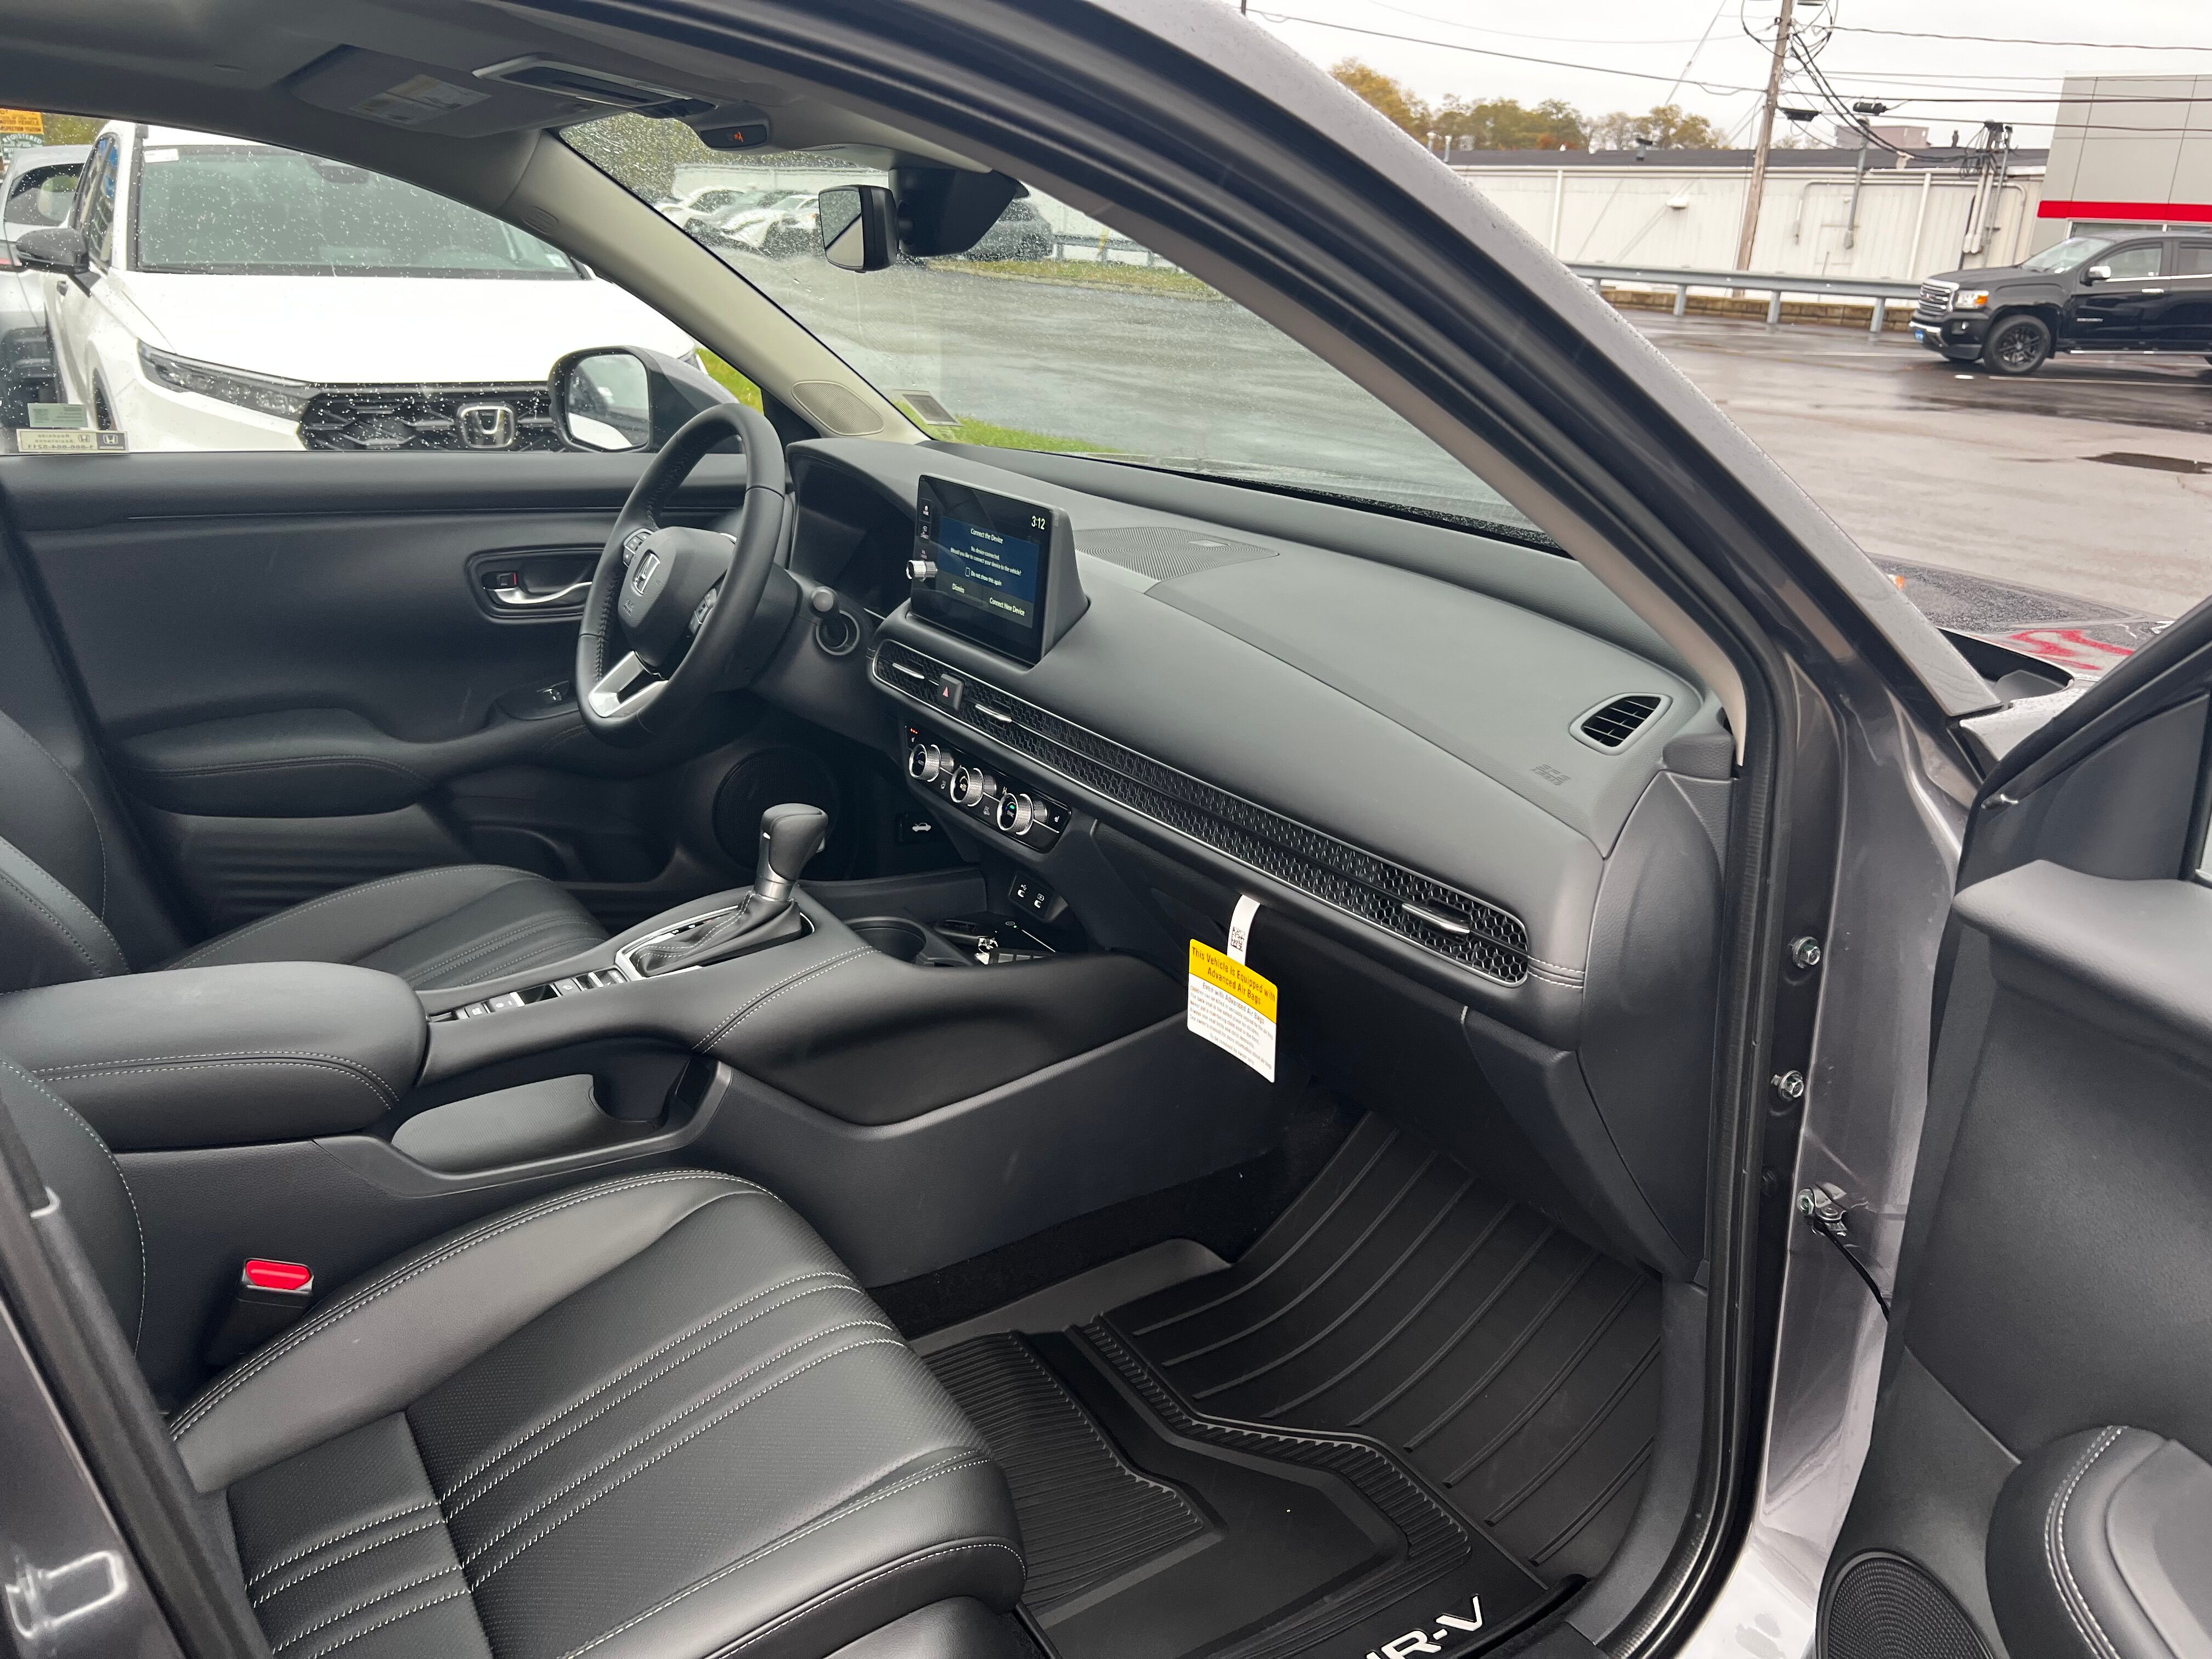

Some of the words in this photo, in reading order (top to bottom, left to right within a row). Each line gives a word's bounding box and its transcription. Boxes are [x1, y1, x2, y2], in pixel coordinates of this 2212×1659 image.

[970, 528, 984, 538] Connect
[991, 534, 1003, 544] Device
[1031, 516, 1045, 530] 3:12
[989, 597, 1003, 608] Connect
[1004, 602, 1012, 611] New
[1013, 606, 1025, 616] Device
[1192, 946, 1204, 960] This
[1207, 953, 1228, 973] Vehicle
[1230, 965, 1234, 977] is
[1237, 968, 1262, 996] Equipped
[1264, 986, 1276, 1003] with
[1207, 966, 1235, 990] Advanced
[1248, 988, 1260, 1007] Bags
[1203, 983, 1213, 992] Even
[1215, 990, 1224, 998] with
[1226, 995, 1246, 1011] Advanced
[1255, 1012, 1265, 1024] Bags
[1366, 1594, 1484, 1659] R-V
